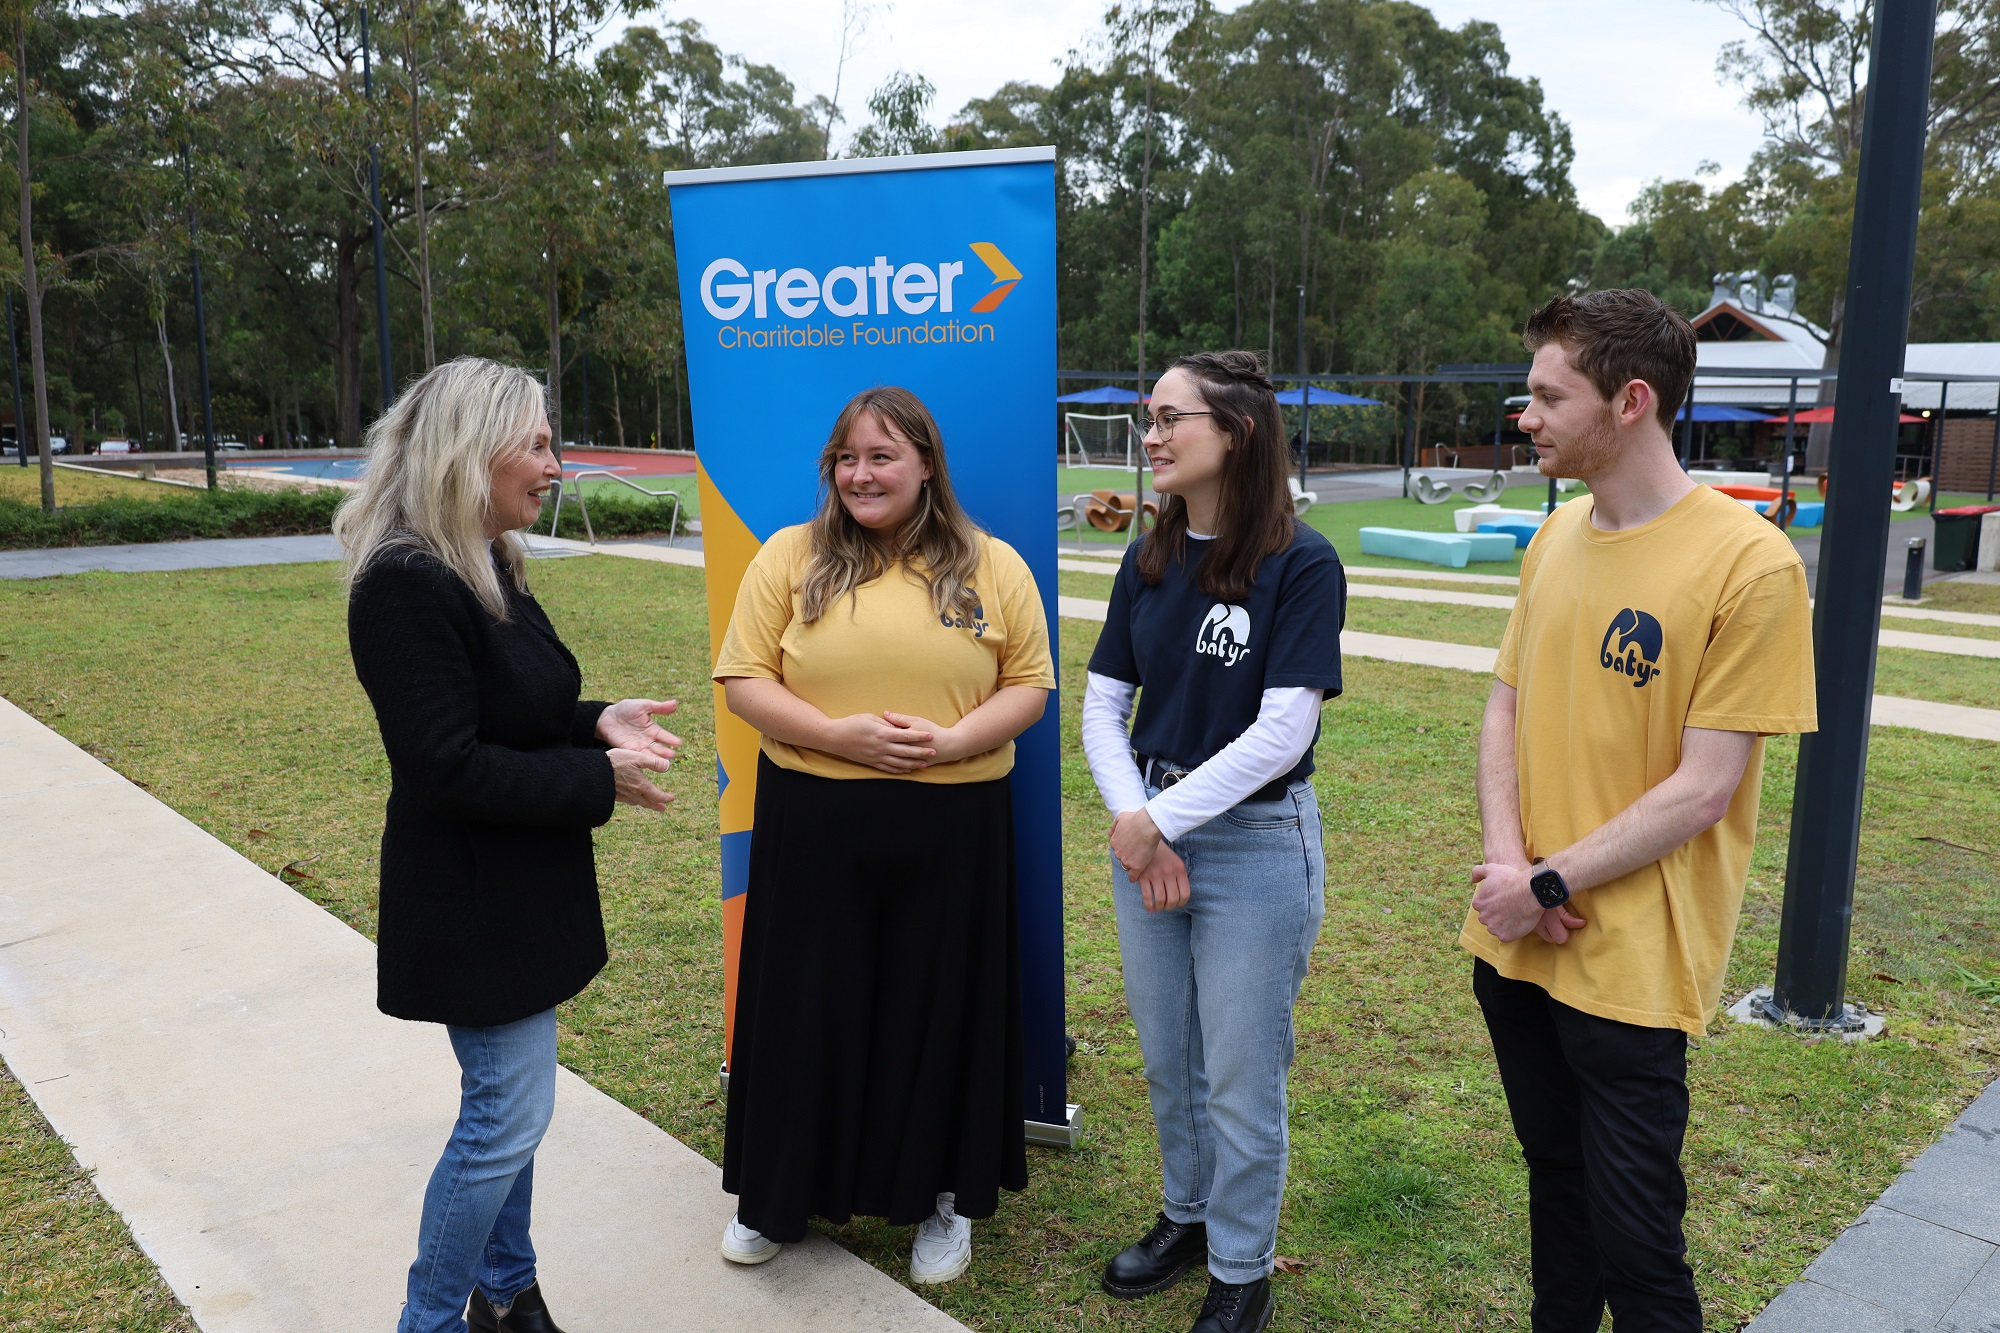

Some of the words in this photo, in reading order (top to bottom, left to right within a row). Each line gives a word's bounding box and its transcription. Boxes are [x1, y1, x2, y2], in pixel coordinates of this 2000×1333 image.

[700, 256, 963, 321] Greater
[718, 323, 845, 349] Charitable
[853, 319, 995, 345] Foundation
[1196, 633, 1250, 667] batyr
[1600, 648, 1660, 688] batyr
